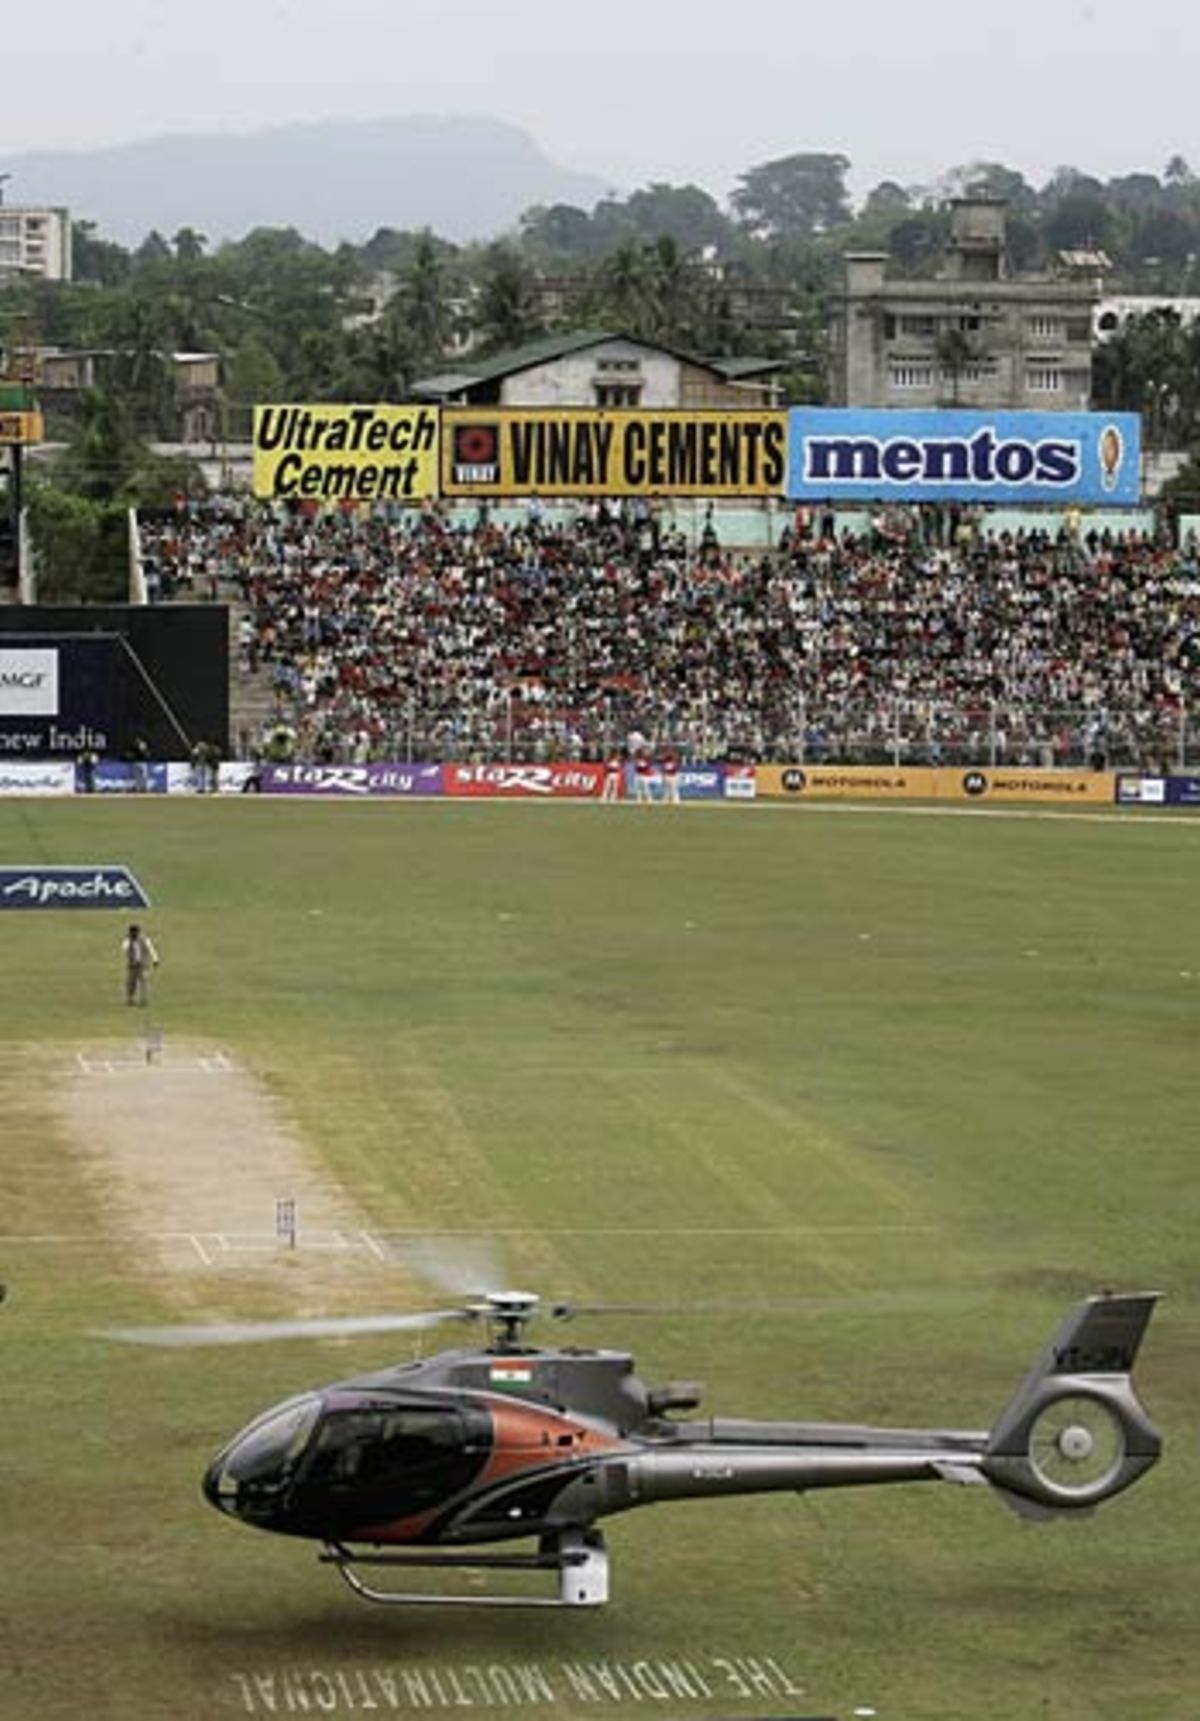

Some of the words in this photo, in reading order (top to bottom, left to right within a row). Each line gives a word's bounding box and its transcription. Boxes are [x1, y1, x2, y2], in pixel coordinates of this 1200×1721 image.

[257, 408, 436, 451] UltraTech
[273, 452, 419, 498] Cement
[509, 420, 614, 486] VINAY
[623, 420, 785, 487] CEMENTS
[805, 428, 1079, 485] mentos
[49, 725, 107, 750] India
[4, 874, 134, 903] Apache
